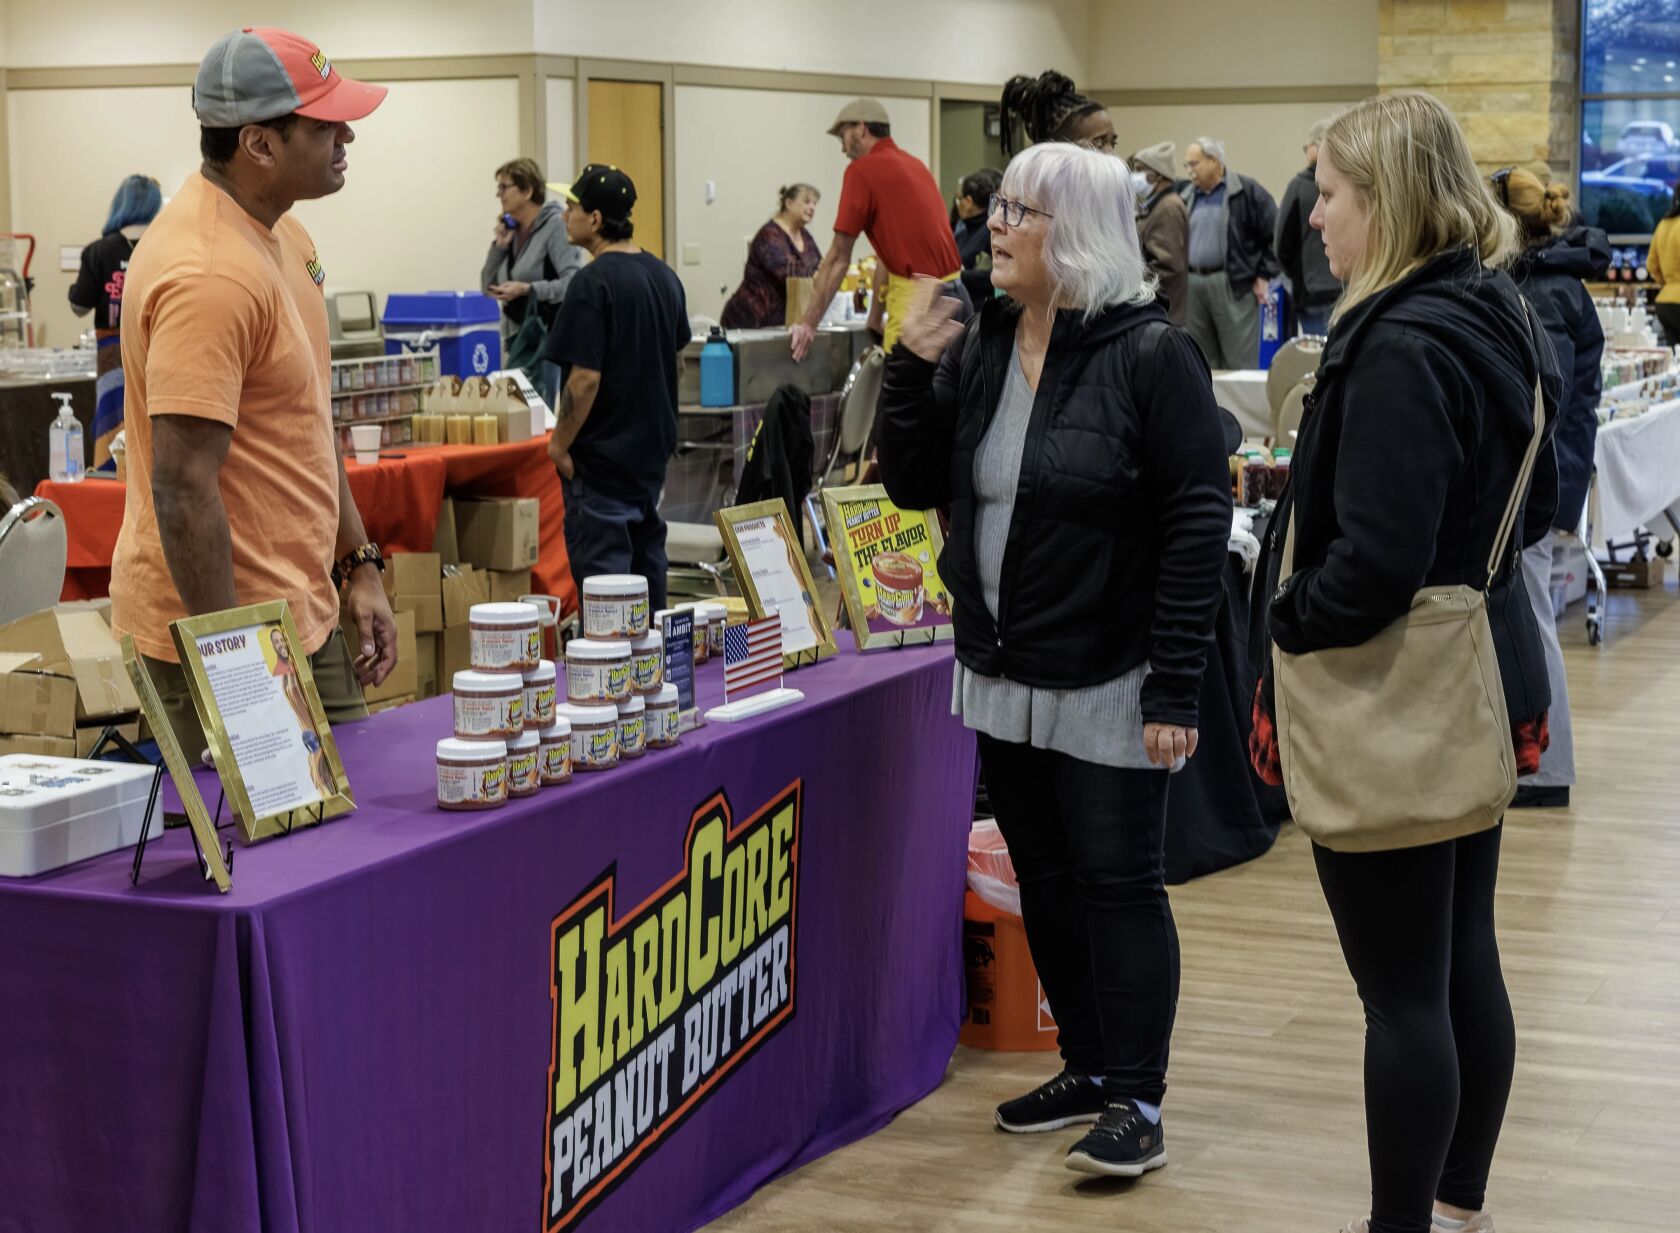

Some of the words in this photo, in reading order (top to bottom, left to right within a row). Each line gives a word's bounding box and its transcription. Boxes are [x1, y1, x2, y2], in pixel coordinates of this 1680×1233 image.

[849, 519, 884, 549] TURN
[884, 512, 901, 534] UP
[881, 523, 928, 552] FLAVOR
[214, 634, 246, 655] STORY
[556, 802, 794, 1116] HARDCORE
[552, 1023, 676, 1218] PEANUT
[682, 924, 789, 1096] BUTTER
